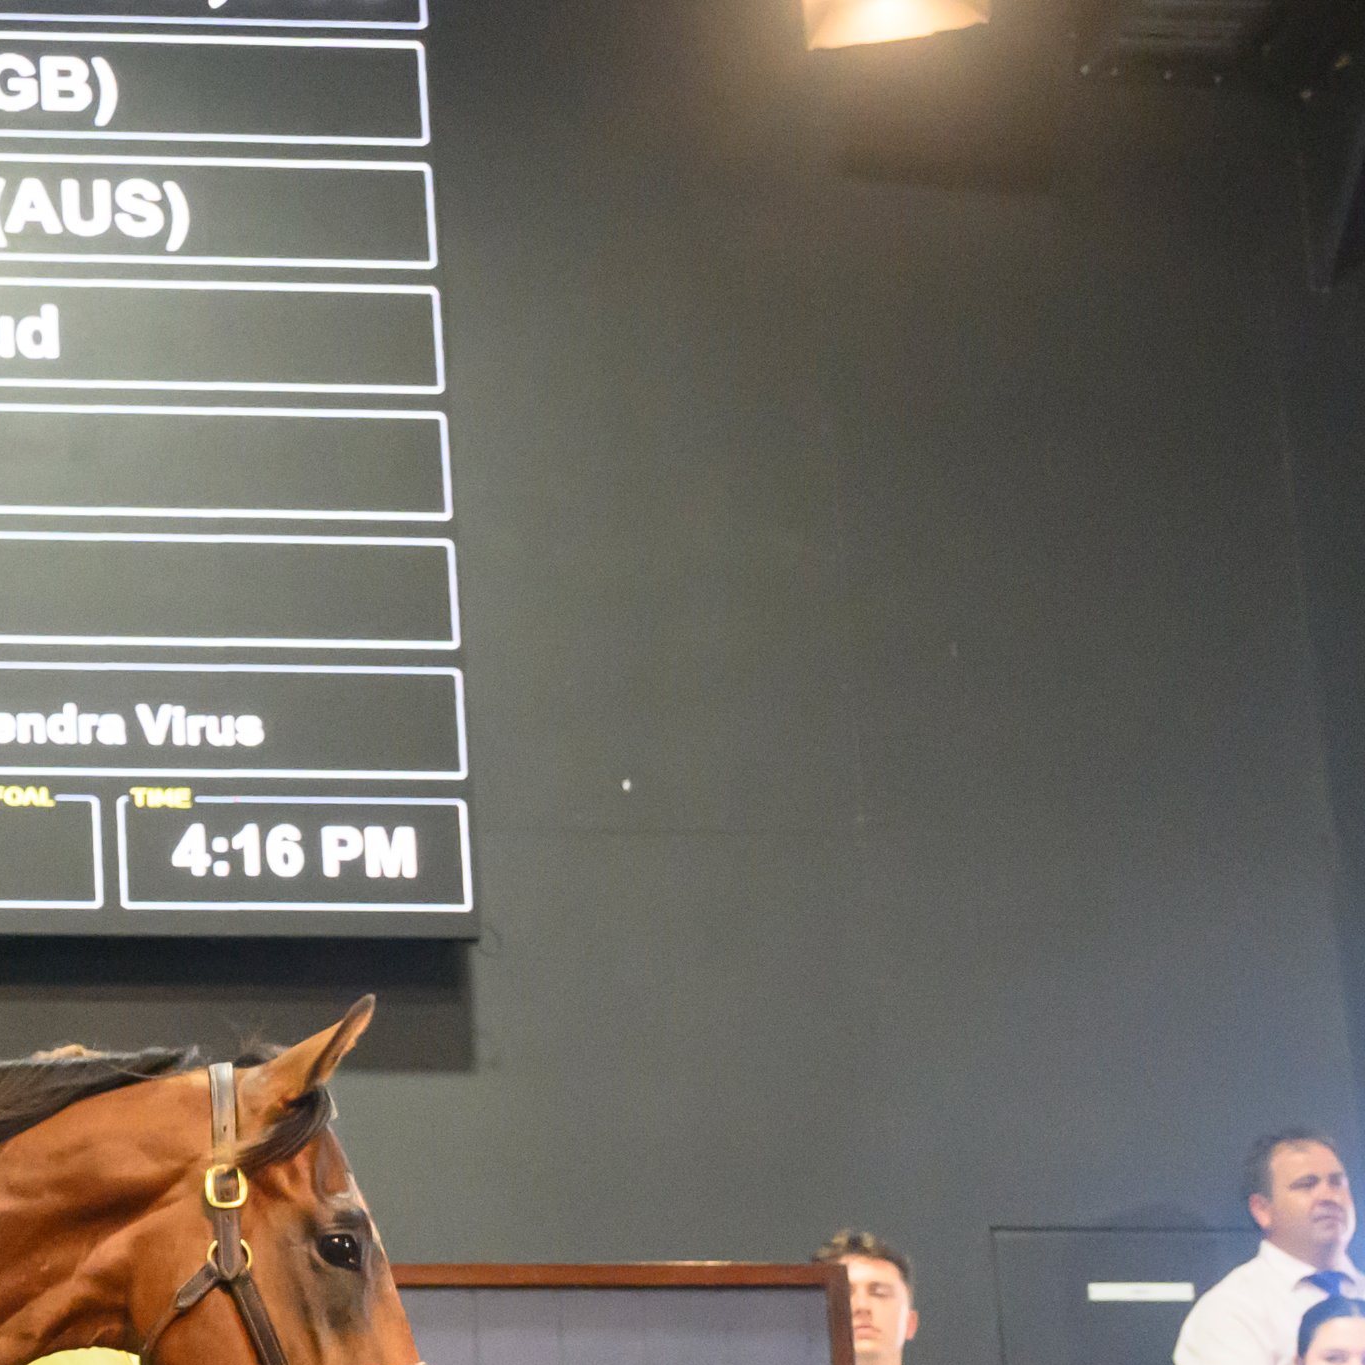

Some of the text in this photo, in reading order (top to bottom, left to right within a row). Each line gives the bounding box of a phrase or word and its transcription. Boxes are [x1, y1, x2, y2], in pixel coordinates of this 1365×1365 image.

[135, 703, 265, 747] Virus
[129, 786, 192, 809] TIME
[171, 823, 418, 879] 4:16 PM
